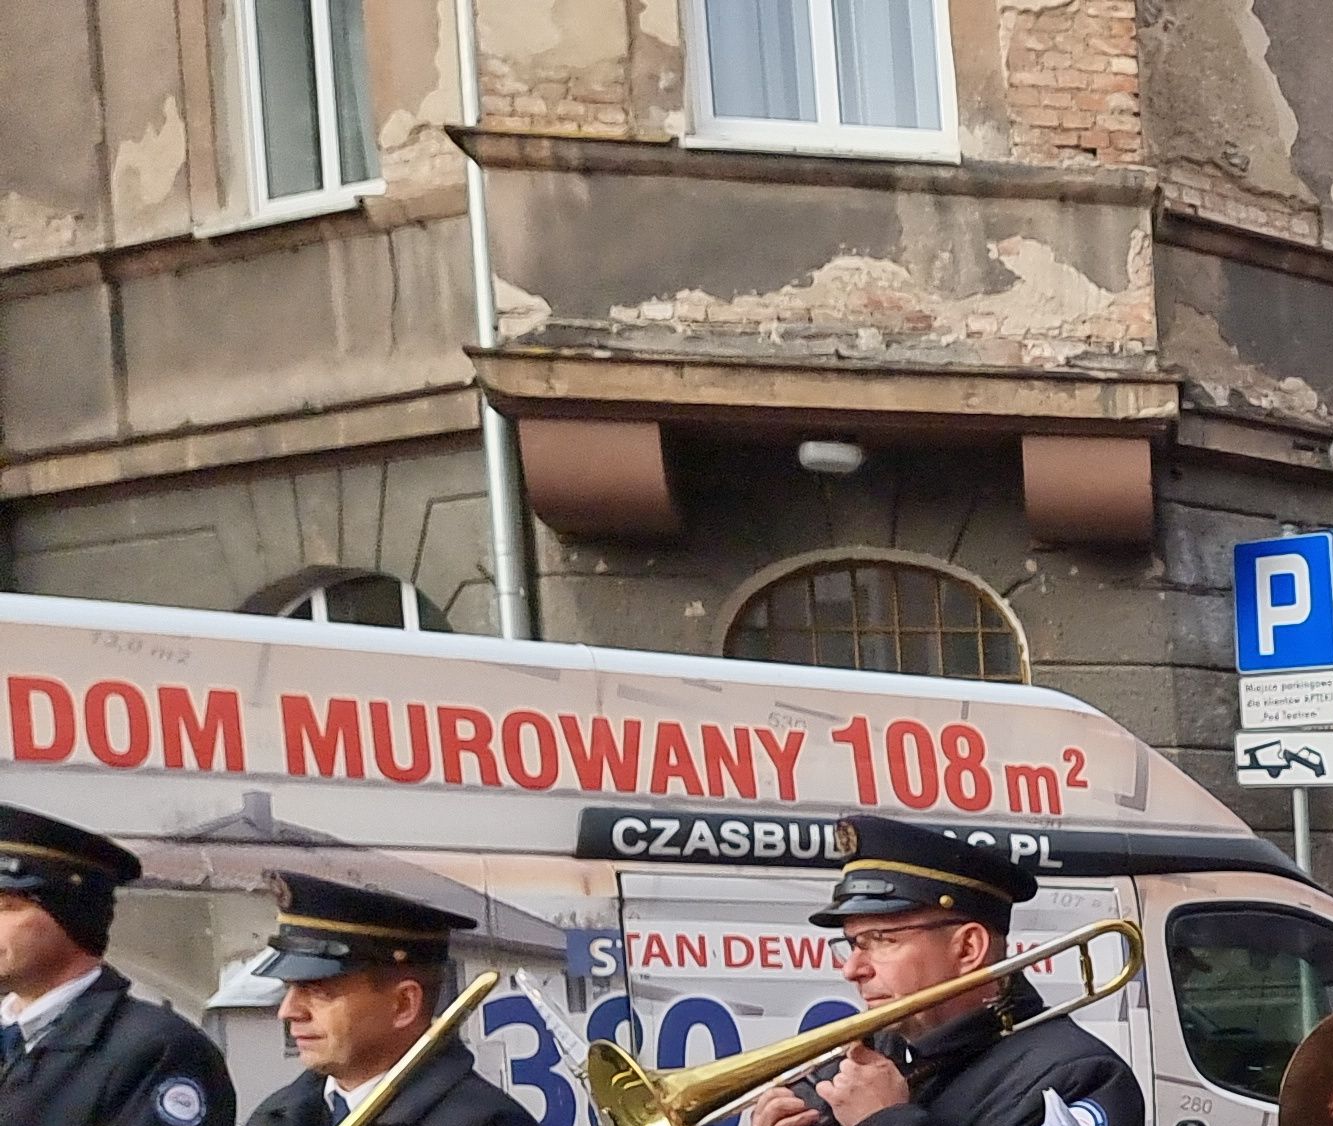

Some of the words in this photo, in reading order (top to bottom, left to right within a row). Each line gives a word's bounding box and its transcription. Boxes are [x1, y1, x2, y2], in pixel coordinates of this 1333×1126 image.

[1255, 553, 1311, 656] P
[8, 676, 244, 773] DOM
[281, 695, 805, 801] MUROWANY
[832, 716, 993, 813] 108
[589, 932, 708, 977] STAN
